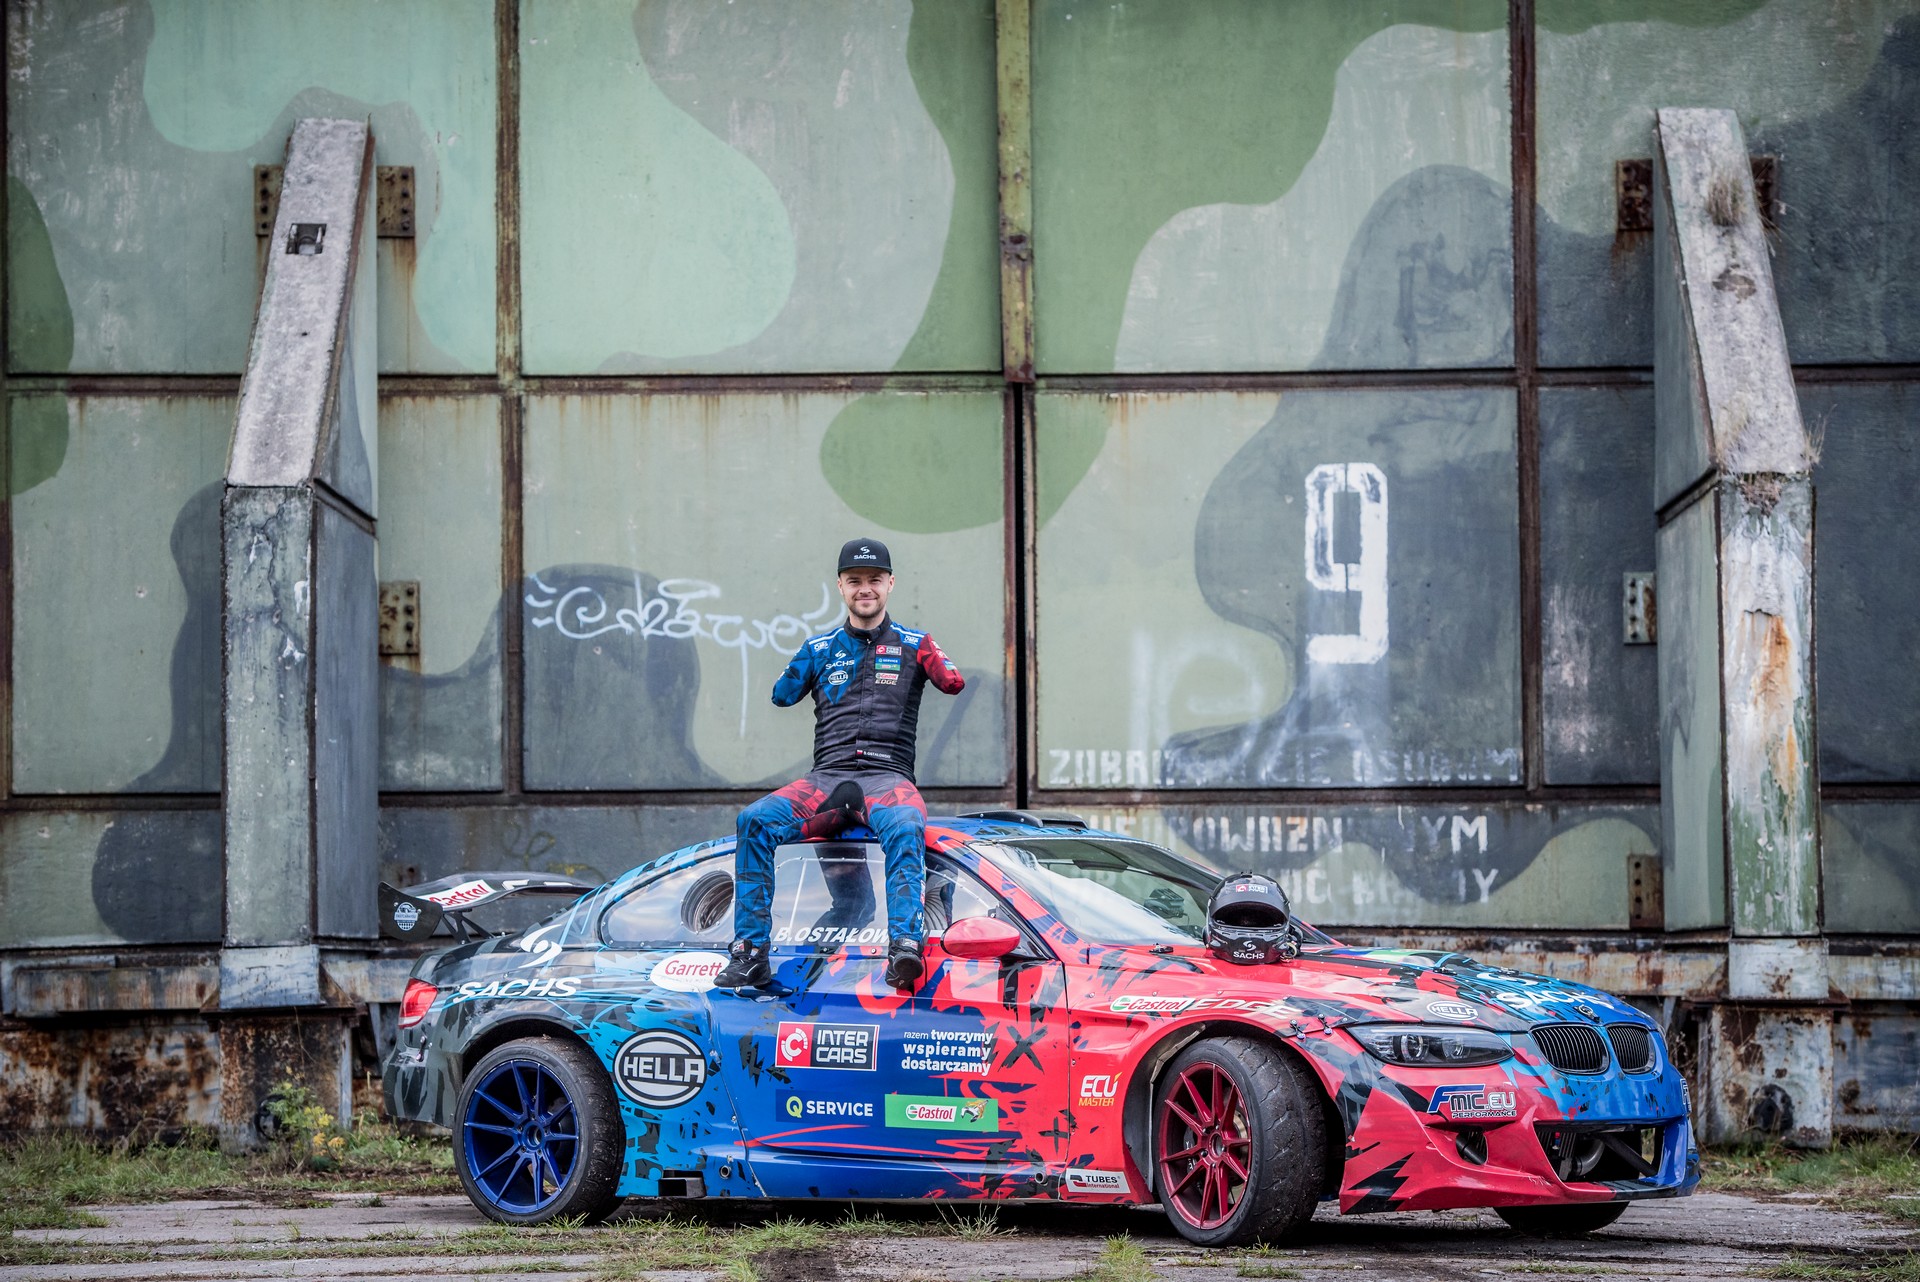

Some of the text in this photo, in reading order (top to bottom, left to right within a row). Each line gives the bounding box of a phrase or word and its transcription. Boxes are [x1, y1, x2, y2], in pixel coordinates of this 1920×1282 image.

[1305, 463, 1389, 665] 9
[825, 660, 855, 669] SACHS
[773, 926, 890, 944] B.OSTAŁOW
[1233, 951, 1264, 959] SACHS
[665, 960, 722, 976] Garrett
[453, 977, 581, 1003] SACHS
[1128, 998, 1301, 1019] Castrol EDGE
[1496, 990, 1615, 1010] SACHS
[1431, 1006, 1479, 1017] HELLA
[817, 1029, 869, 1047] INTER
[903, 1029, 993, 1045] razem tworzymy
[815, 1046, 867, 1064] CARS
[903, 1041, 991, 1061] wspieramy
[623, 1056, 705, 1084] HELLA
[901, 1056, 991, 1077] dostarczamy
[1080, 1071, 1122, 1098] ECU
[786, 1095, 874, 1118] Q SERVICE
[1078, 1097, 1115, 1107] MASTER
[918, 1106, 953, 1120] Castrol
[1451, 1110, 1517, 1119] PERFORMANCE
[1085, 1175, 1118, 1184] TUBES
